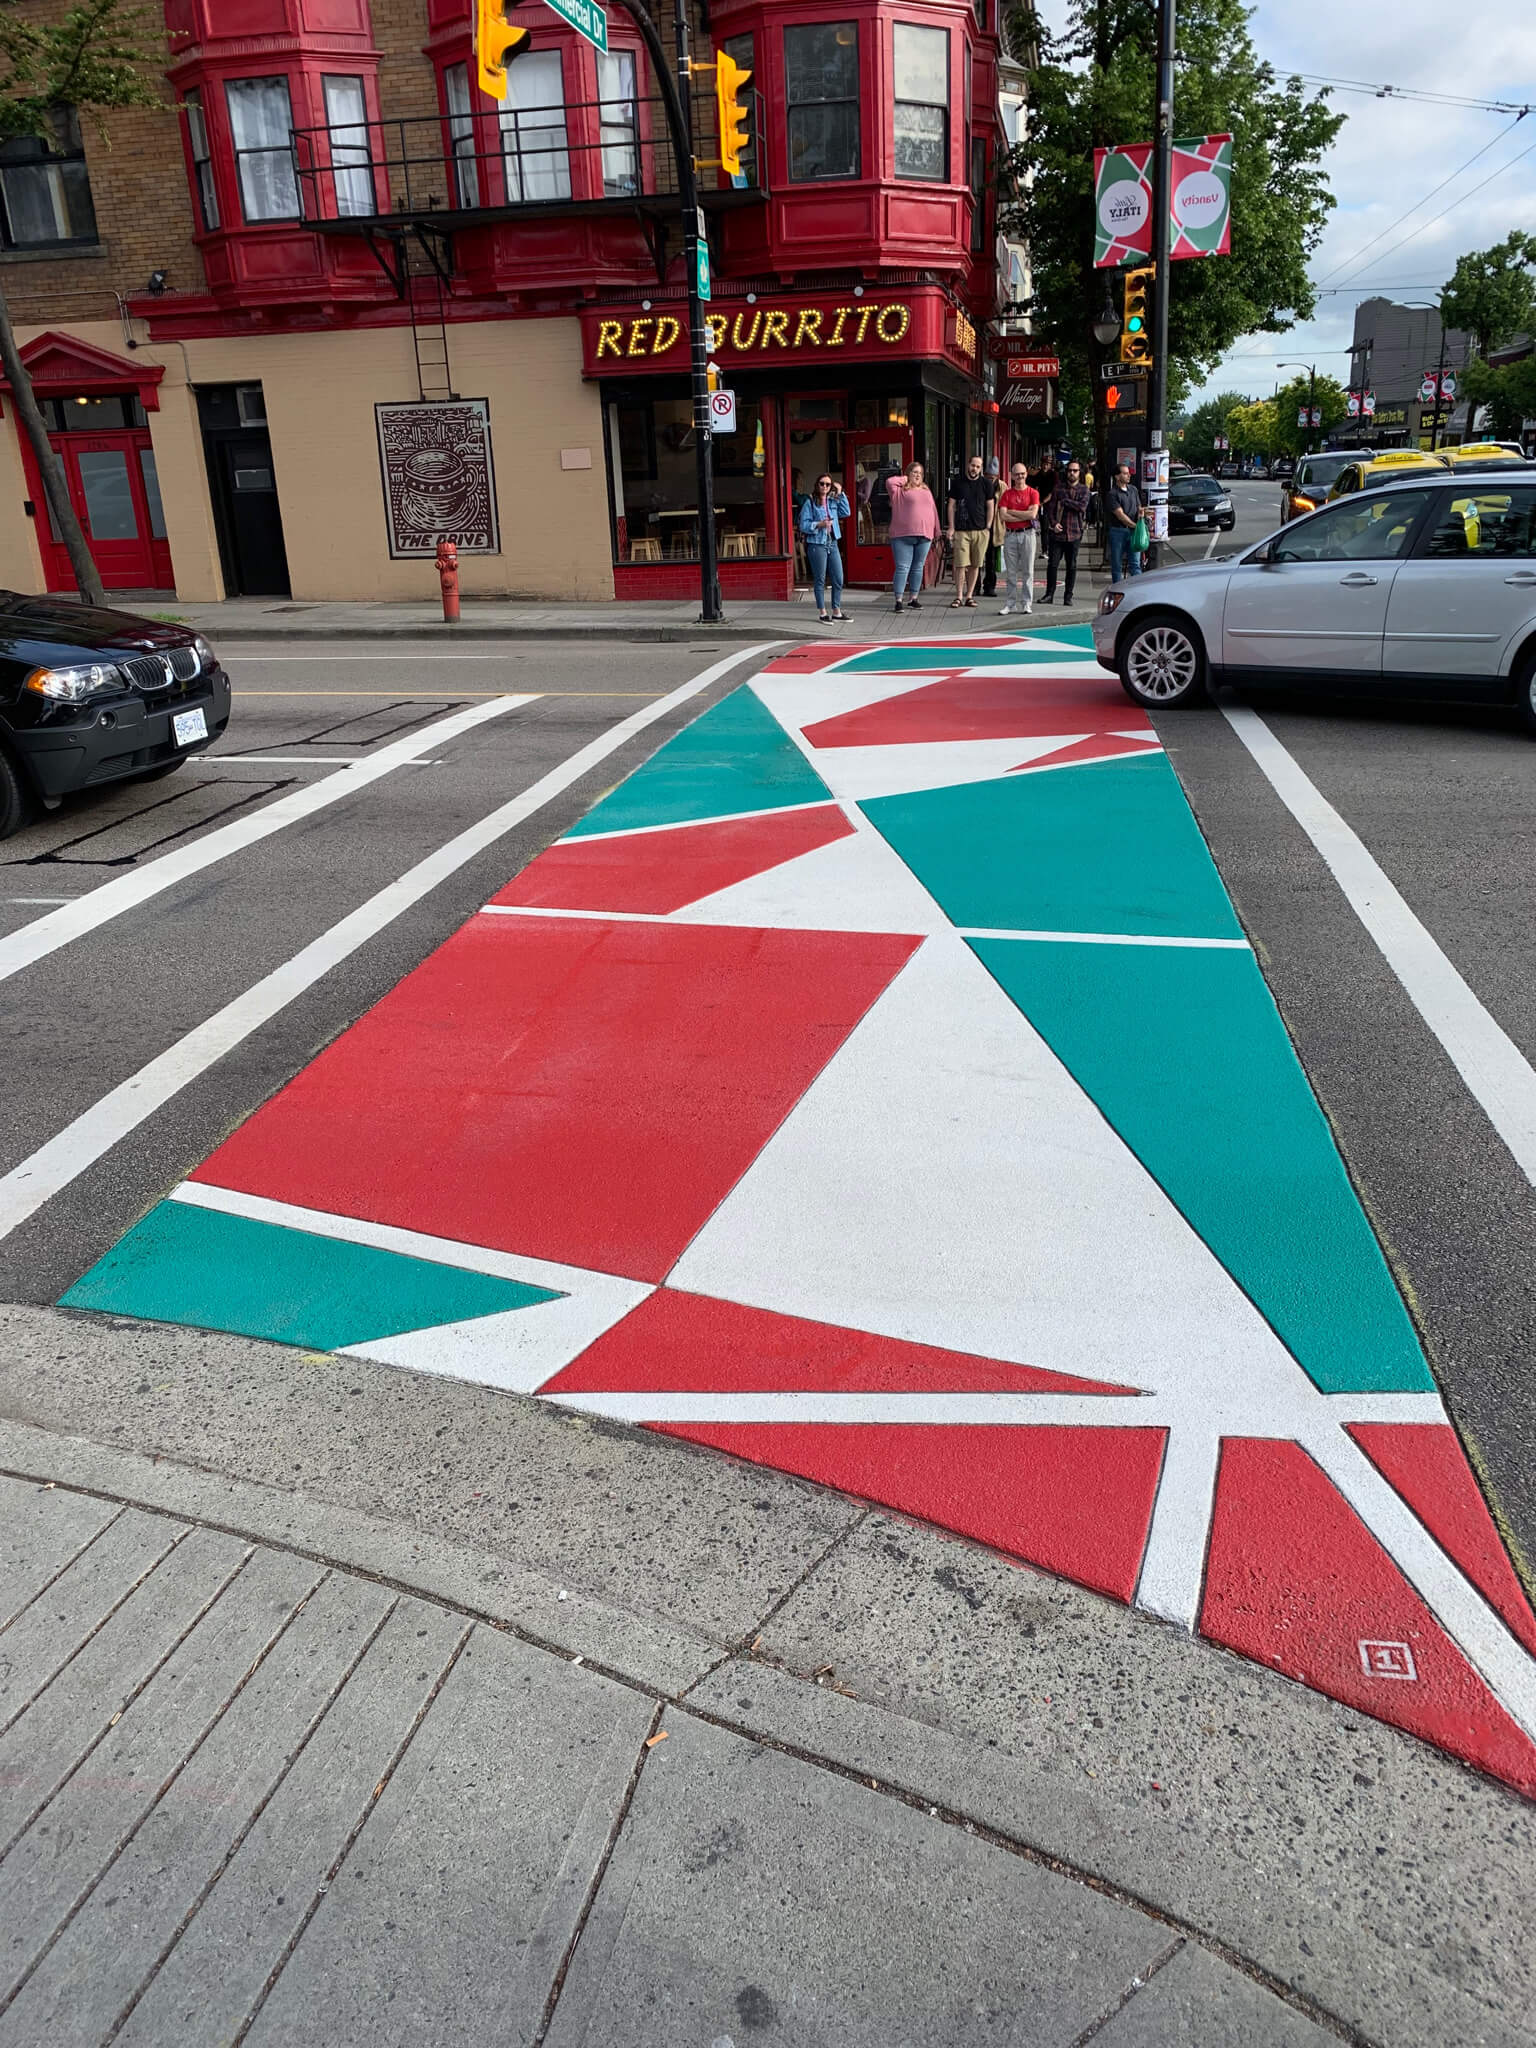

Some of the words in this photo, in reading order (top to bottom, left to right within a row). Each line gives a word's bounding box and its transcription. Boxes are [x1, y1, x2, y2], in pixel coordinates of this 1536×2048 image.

[592, 10, 604, 42] Dr
[595, 316, 681, 359] RED
[704, 303, 912, 351] BURRITO
[1022, 364, 1036, 374] MR.
[1037, 362, 1057, 373] PET'S
[1107, 366, 1114, 377] E
[400, 534, 433, 547] THE
[437, 533, 485, 547] DRIVE
